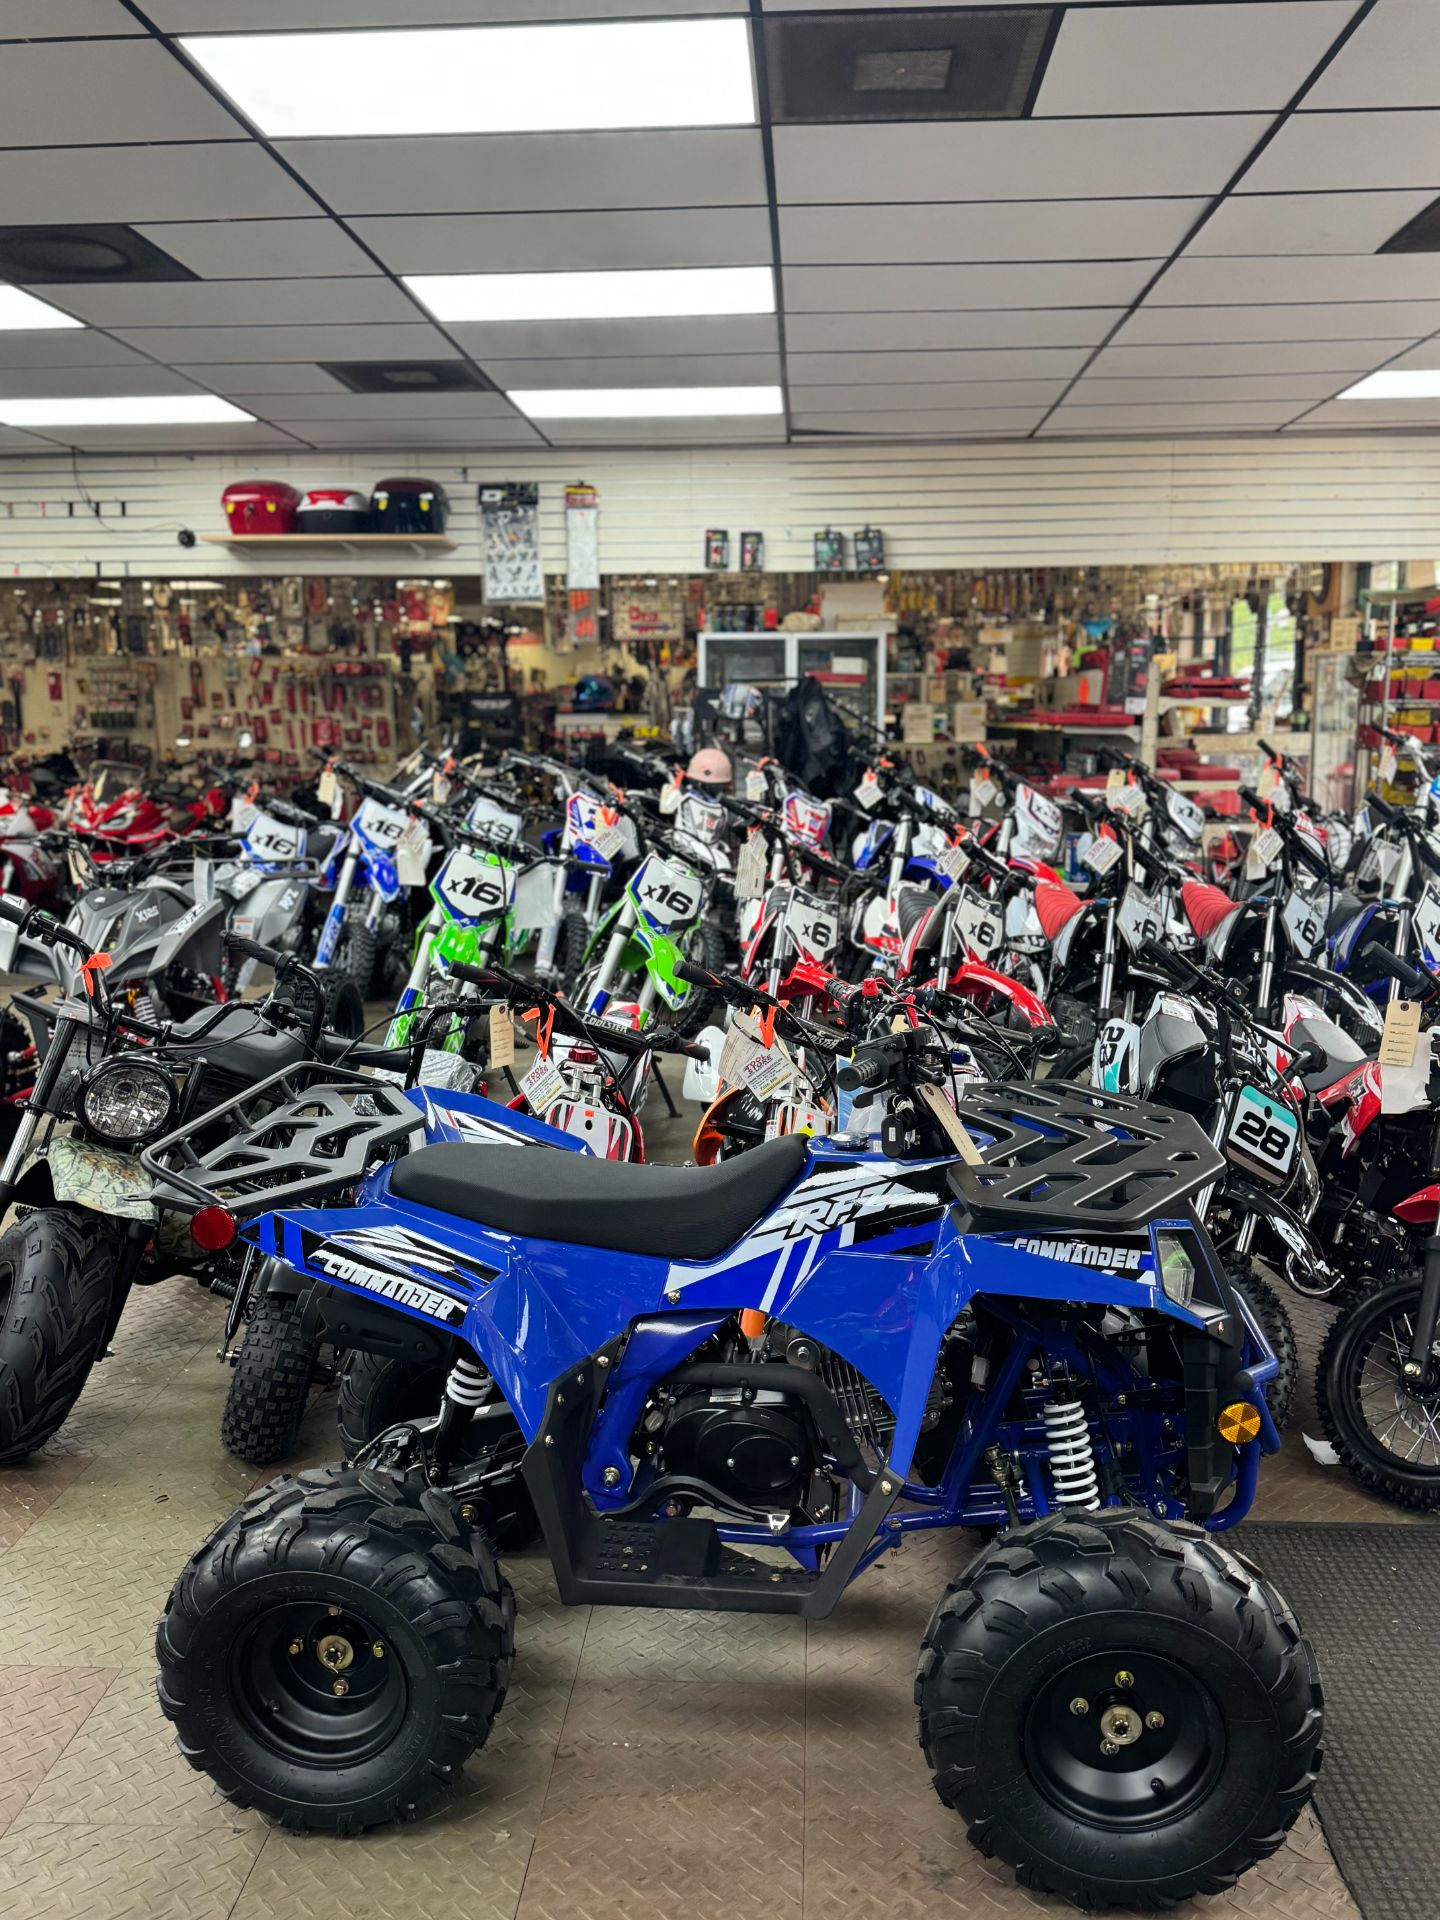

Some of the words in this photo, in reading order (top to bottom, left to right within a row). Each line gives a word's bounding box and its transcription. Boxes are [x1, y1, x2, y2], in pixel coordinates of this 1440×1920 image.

[447, 877, 502, 905] x16
[642, 884, 693, 915] x16
[801, 921, 832, 948] x6
[969, 920, 996, 948] x6
[1132, 918, 1158, 941] x6
[1294, 917, 1318, 946] x6
[582, 1013, 629, 1034] COOLSTER
[744, 1053, 766, 1073] TOOL
[1234, 1110, 1291, 1161] 28
[1013, 1237, 1142, 1270] COMMANDER
[320, 1250, 456, 1321] COMMANDER
